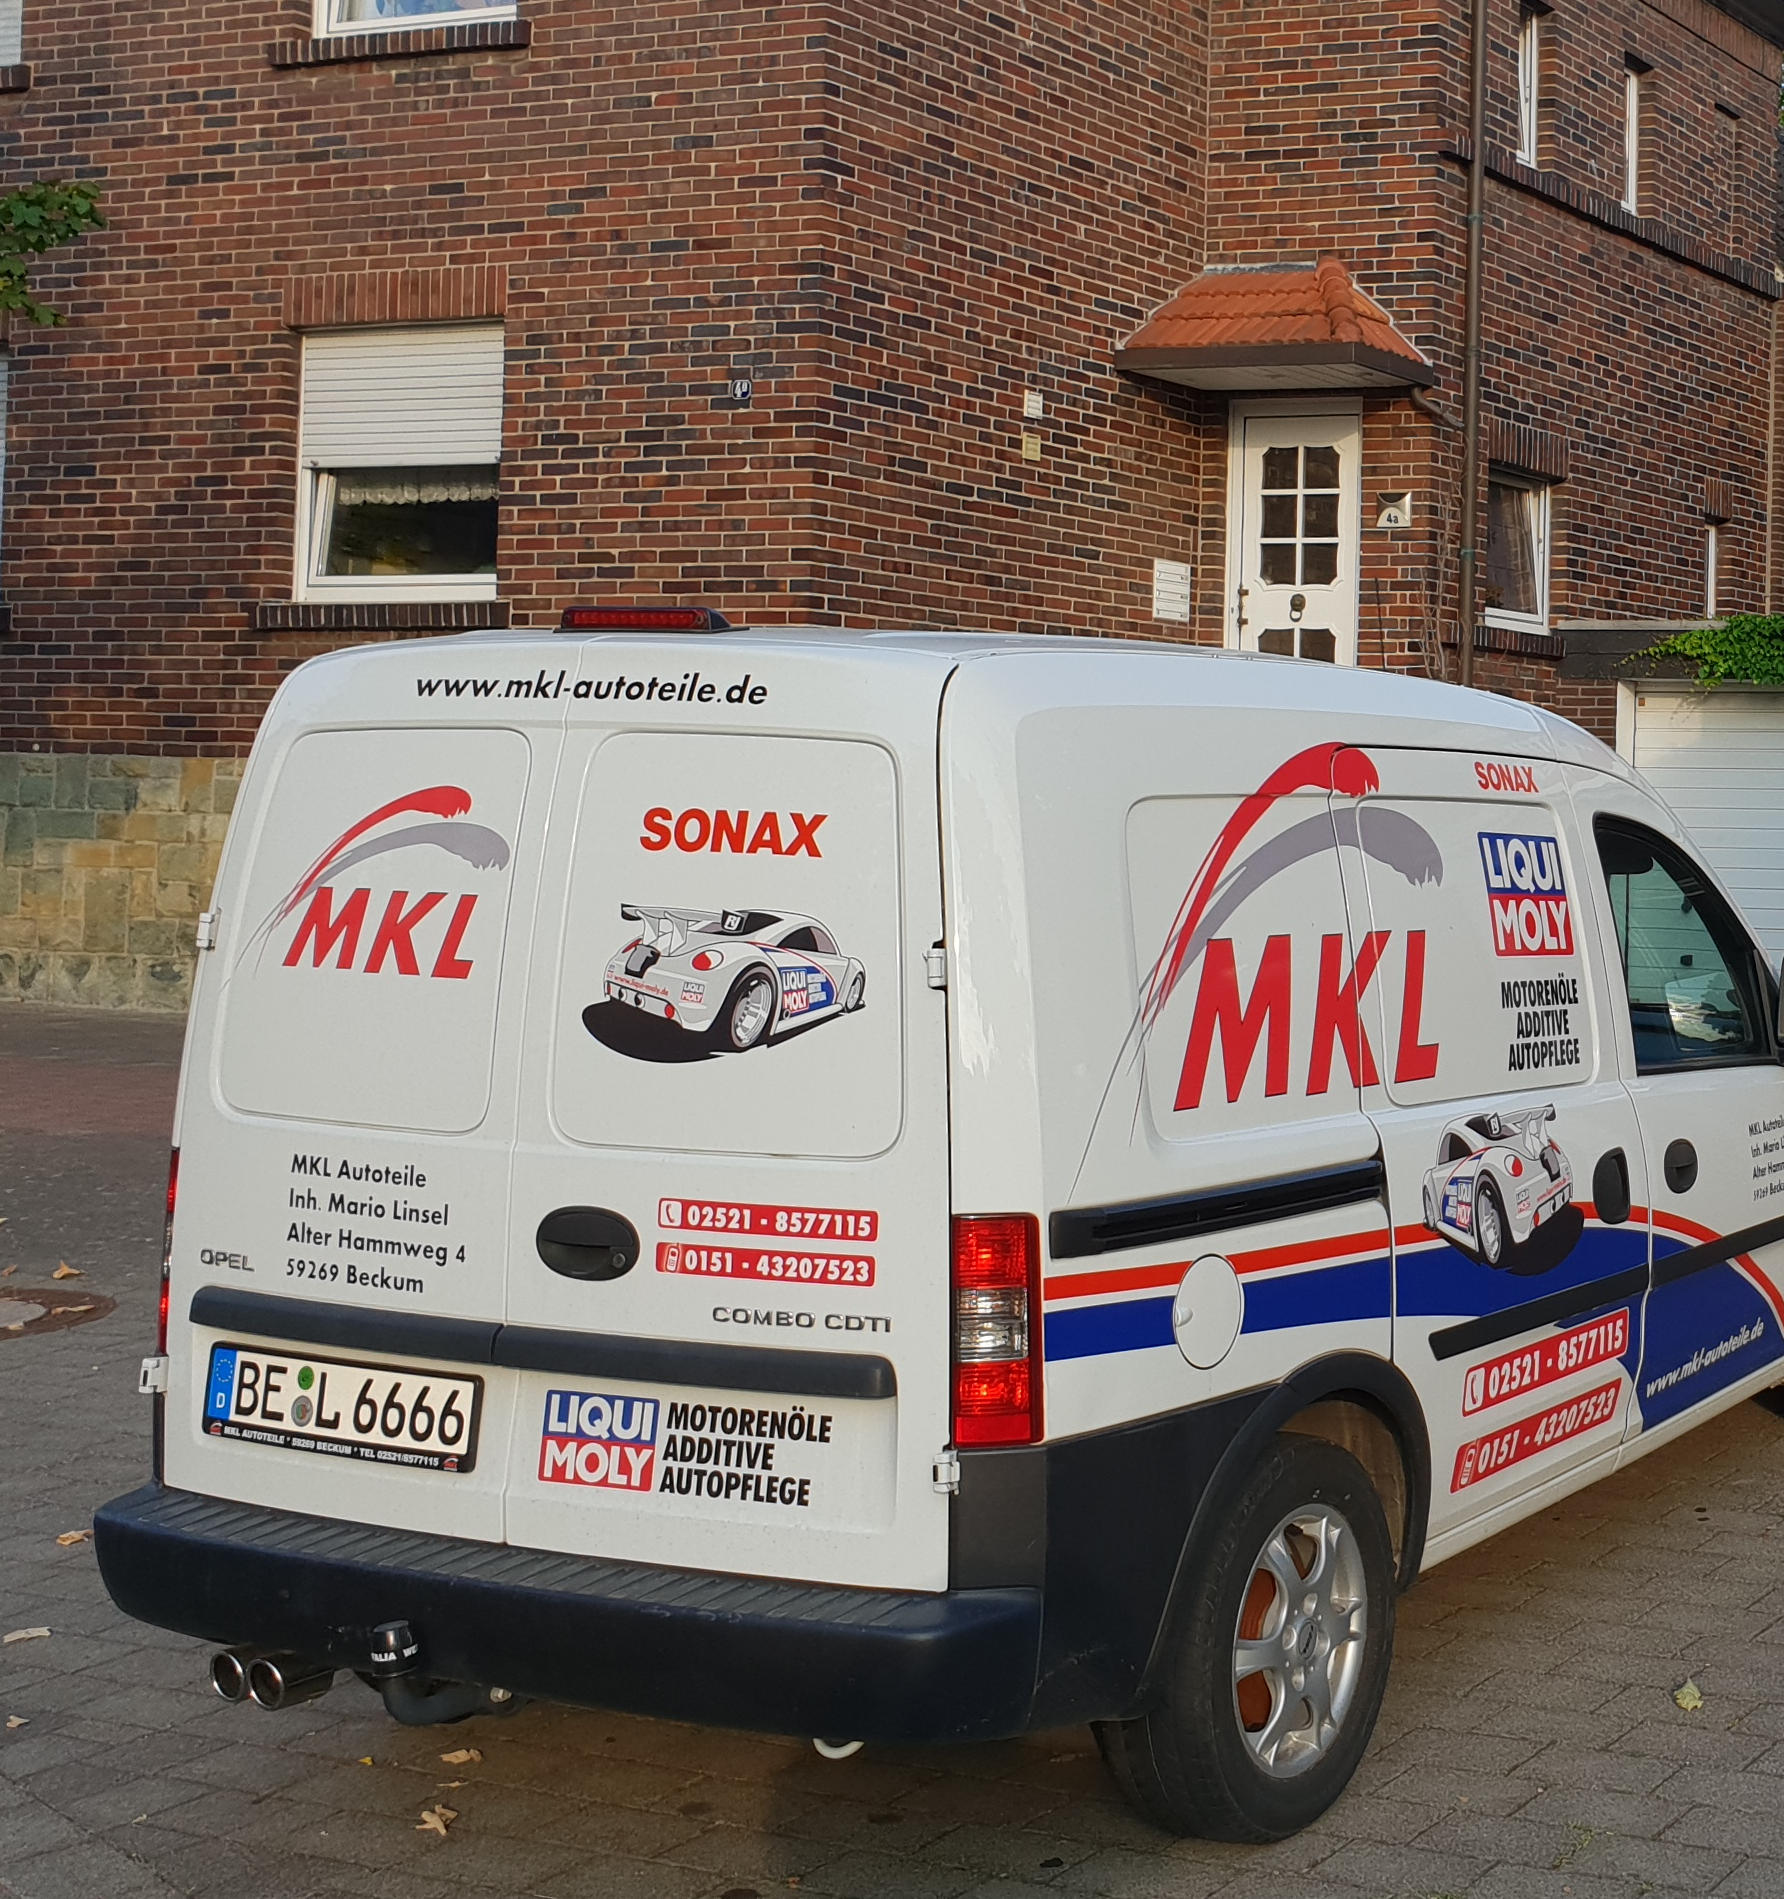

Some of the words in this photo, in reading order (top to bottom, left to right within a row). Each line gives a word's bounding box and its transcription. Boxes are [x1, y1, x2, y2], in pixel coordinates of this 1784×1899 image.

[1386, 512, 1399, 524] 4a
[415, 669, 768, 706] www.mkl-autoteile.de
[1474, 761, 1539, 794] SONAX
[639, 806, 828, 859] SONAX
[1480, 835, 1563, 894] LIQUI
[282, 884, 479, 980] MKL
[1493, 896, 1571, 955] MOLY
[1500, 972, 1579, 1010] MOTORENÖLE
[1173, 929, 1440, 1112] MKL
[1516, 1009, 1570, 1038] ADDITIVE
[1507, 1038, 1581, 1072] AUTOPFLEGE
[1748, 1121, 1762, 1136] MKL
[1763, 1138, 1780, 1154] Mario
[290, 1152, 332, 1179] MKL
[337, 1157, 427, 1188] Autoteile
[288, 1188, 322, 1212] Inh.
[329, 1193, 386, 1219] Mario
[392, 1198, 449, 1227] Linsel
[687, 1205, 752, 1232] 02521
[775, 1211, 872, 1239] 8577115
[200, 1248, 255, 1272] OPEL
[286, 1223, 332, 1248] Alter
[338, 1228, 449, 1266] Hammweg
[456, 1243, 467, 1265] 4
[285, 1257, 338, 1283] 59269
[346, 1263, 424, 1293] Beckum
[684, 1248, 734, 1274] 0151
[755, 1255, 872, 1284] 43207523
[712, 1306, 816, 1331] COMBO
[824, 1312, 893, 1334] CDTI
[1489, 1349, 1541, 1398] 02521
[1557, 1317, 1624, 1372] 8577115
[1645, 1316, 1764, 1399] www.mkl-autoteile.de
[216, 1392, 227, 1409] D
[234, 1360, 288, 1422] BE
[315, 1371, 341, 1429] L
[353, 1378, 466, 1447] 6666
[547, 1393, 655, 1442] LIQUI
[666, 1401, 833, 1443] MOTORENÖLE
[241, 1428, 285, 1445] AUTOTEILE
[359, 1447, 376, 1459] TEL
[1477, 1428, 1520, 1473] 0151
[1534, 1387, 1616, 1447] 43207523
[541, 1440, 654, 1487] MOLY
[661, 1433, 774, 1471] ADDITIVE
[658, 1467, 811, 1508] AUTOPFLEGE
